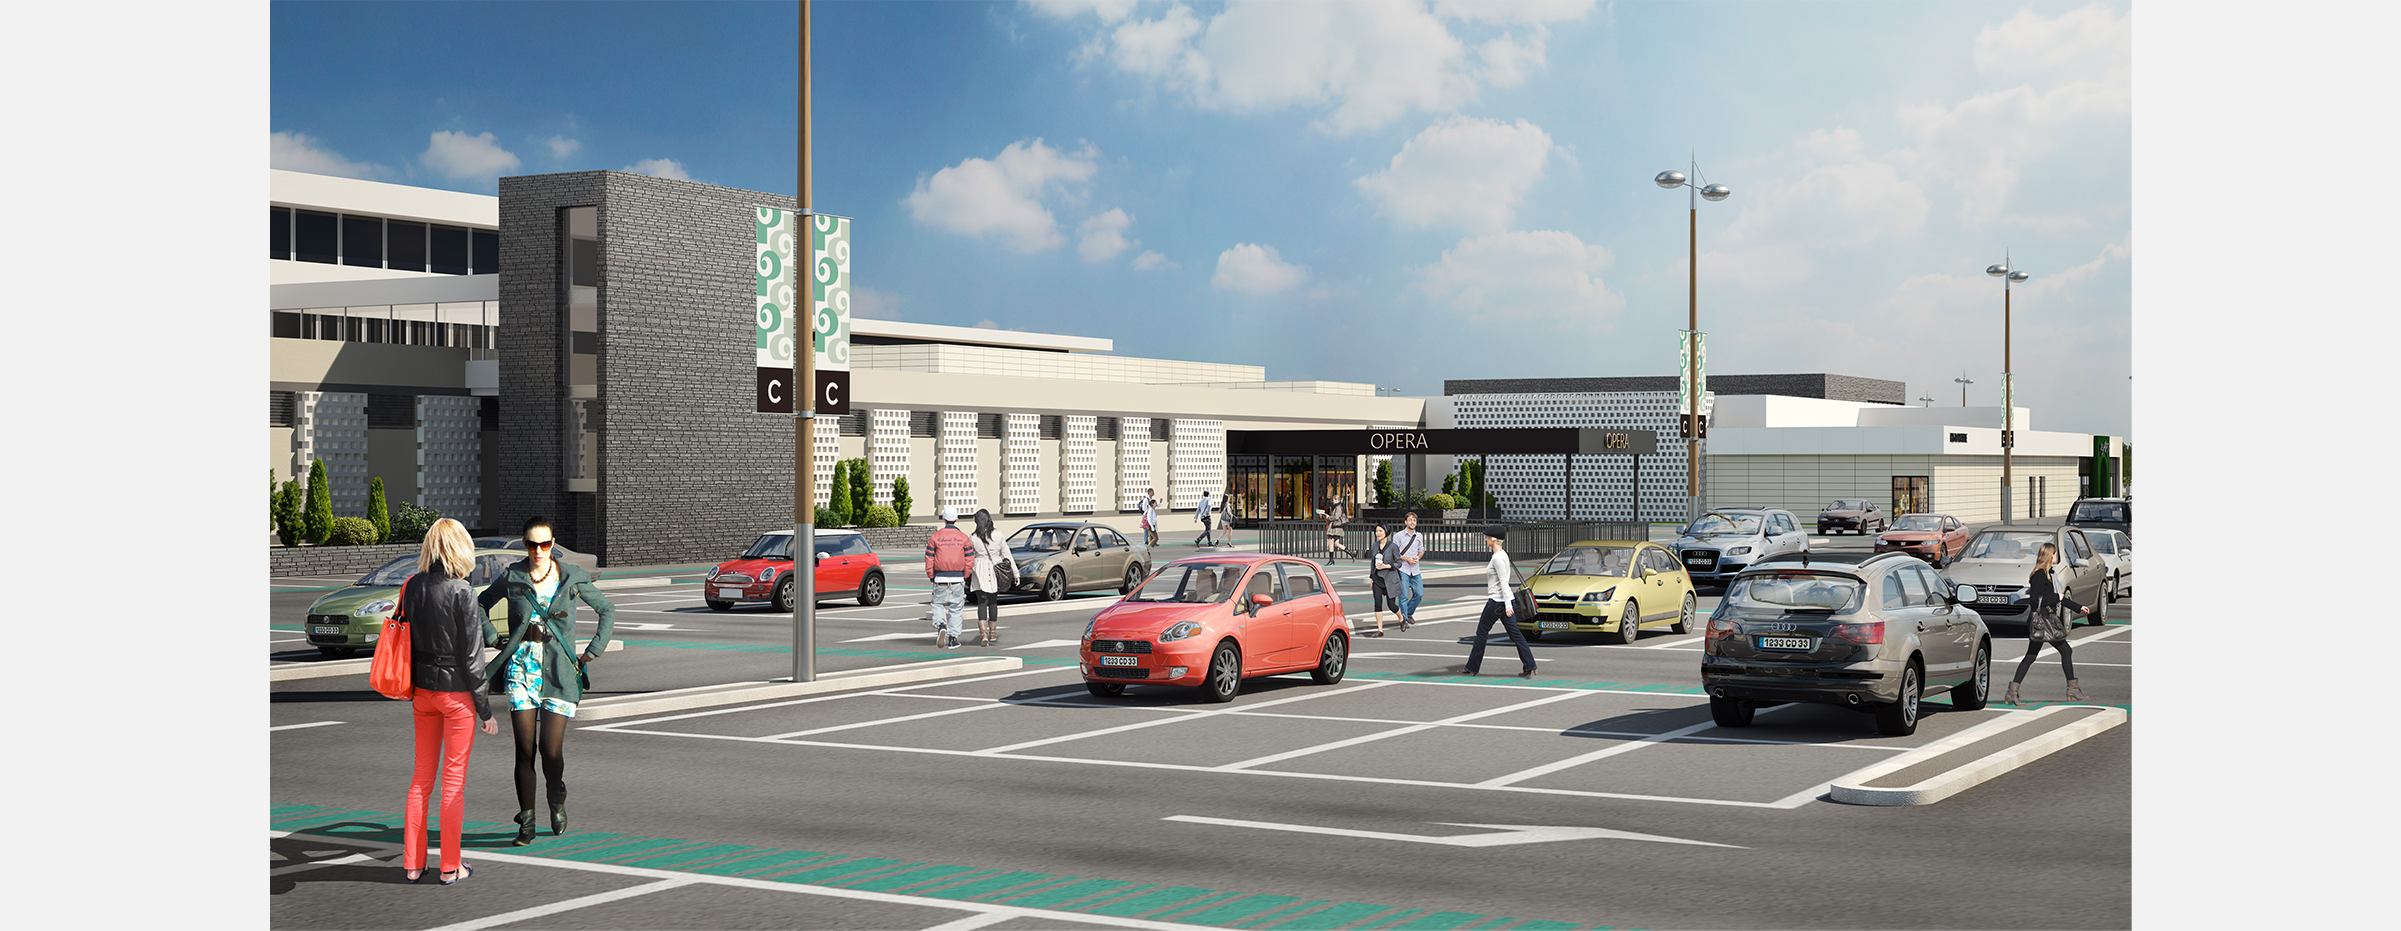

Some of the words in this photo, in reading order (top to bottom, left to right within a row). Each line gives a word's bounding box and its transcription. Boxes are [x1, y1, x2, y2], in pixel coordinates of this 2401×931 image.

[767, 379, 782, 404] C
[825, 381, 839, 406] C
[1682, 420, 1688, 433] C
[1698, 420, 1704, 434] C
[1370, 432, 1429, 450] OPERA
[1605, 432, 1630, 449] OPERA
[1764, 638, 1784, 648] 1233
[1785, 638, 1797, 648] CD
[1797, 639, 1809, 648] 33
[1104, 657, 1118, 665] 1233
[1128, 657, 1137, 666] 33
